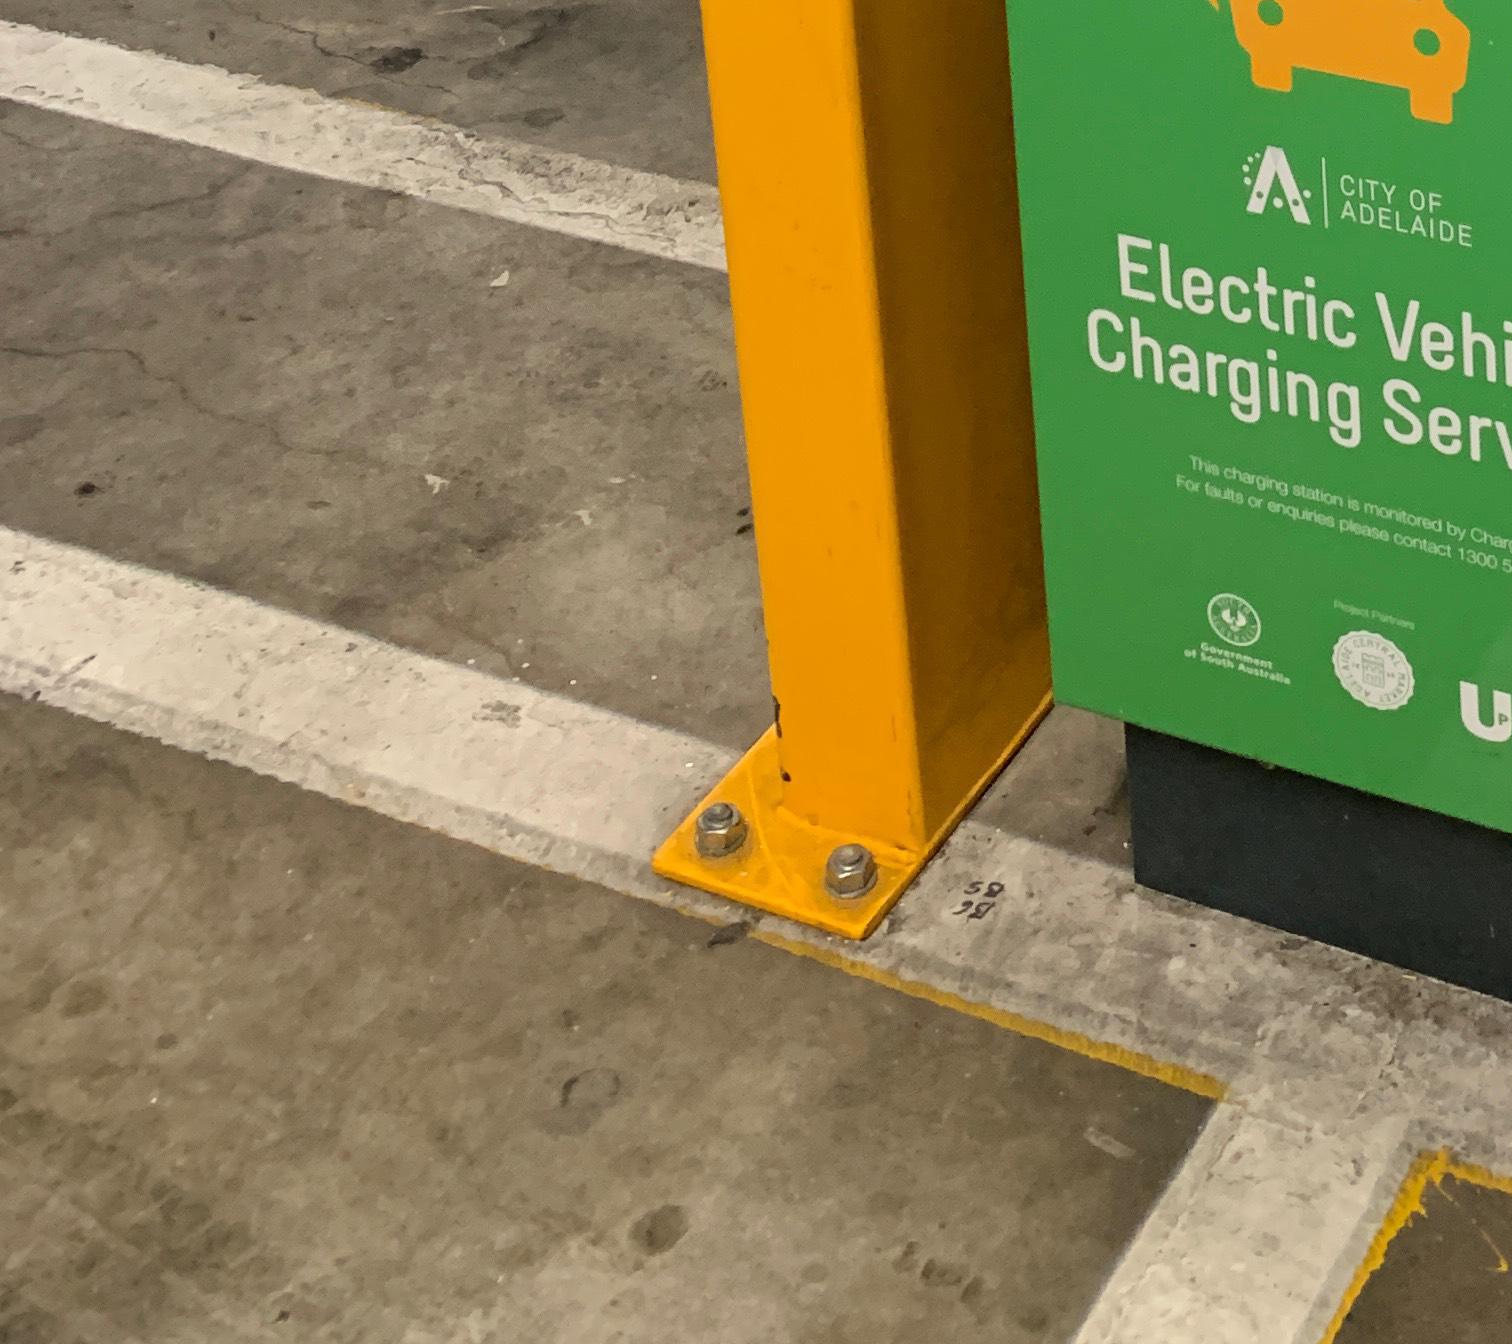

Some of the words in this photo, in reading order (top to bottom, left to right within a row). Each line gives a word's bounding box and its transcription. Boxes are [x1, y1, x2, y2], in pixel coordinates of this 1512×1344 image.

[1340, 174, 1397, 205] CITY
[1409, 188, 1443, 214] OF
[1340, 199, 1473, 248] ADELAIDE
[1117, 233, 1357, 349] Electric
[1087, 308, 1362, 449] Charging
[1176, 473, 1201, 493] For
[1204, 481, 1244, 505] faults
[1247, 495, 1265, 509] or
[1266, 500, 1336, 528] enquiries
[1336, 518, 1391, 542] please
[1392, 532, 1452, 559] contact
[1457, 546, 1499, 570] 1300
[1188, 454, 1220, 477] This
[1222, 466, 1289, 497] charging
[1292, 484, 1344, 508] station
[1347, 495, 1361, 512] is
[1363, 502, 1443, 533] monitored
[1446, 520, 1467, 542] by
[1183, 648, 1198, 659] of
[1200, 649, 1235, 669] South
[1237, 662, 1292, 686] Australia
[1200, 641, 1273, 670] Government
